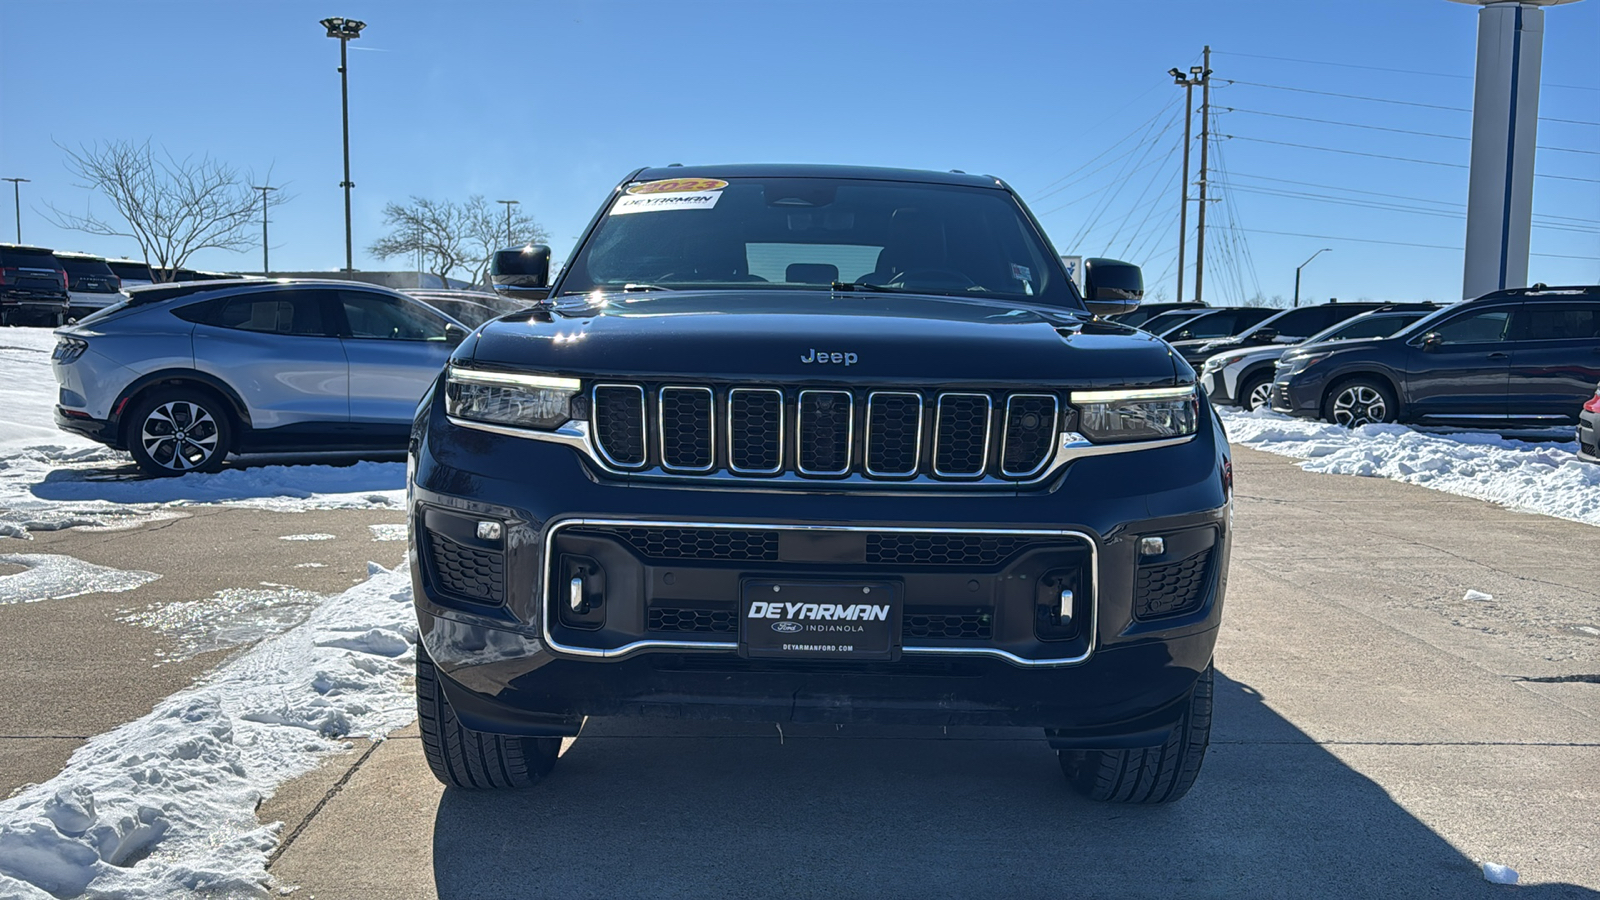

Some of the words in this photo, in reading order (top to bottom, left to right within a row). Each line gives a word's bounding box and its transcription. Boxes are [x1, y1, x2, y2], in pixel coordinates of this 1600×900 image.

[640, 181, 719, 193] 2023
[623, 195, 713, 206] DEYARMAN
[801, 348, 858, 366] Jeep
[747, 601, 891, 621] DEYARMAN
[783, 643, 853, 651] DEYARMANFORD.COM
